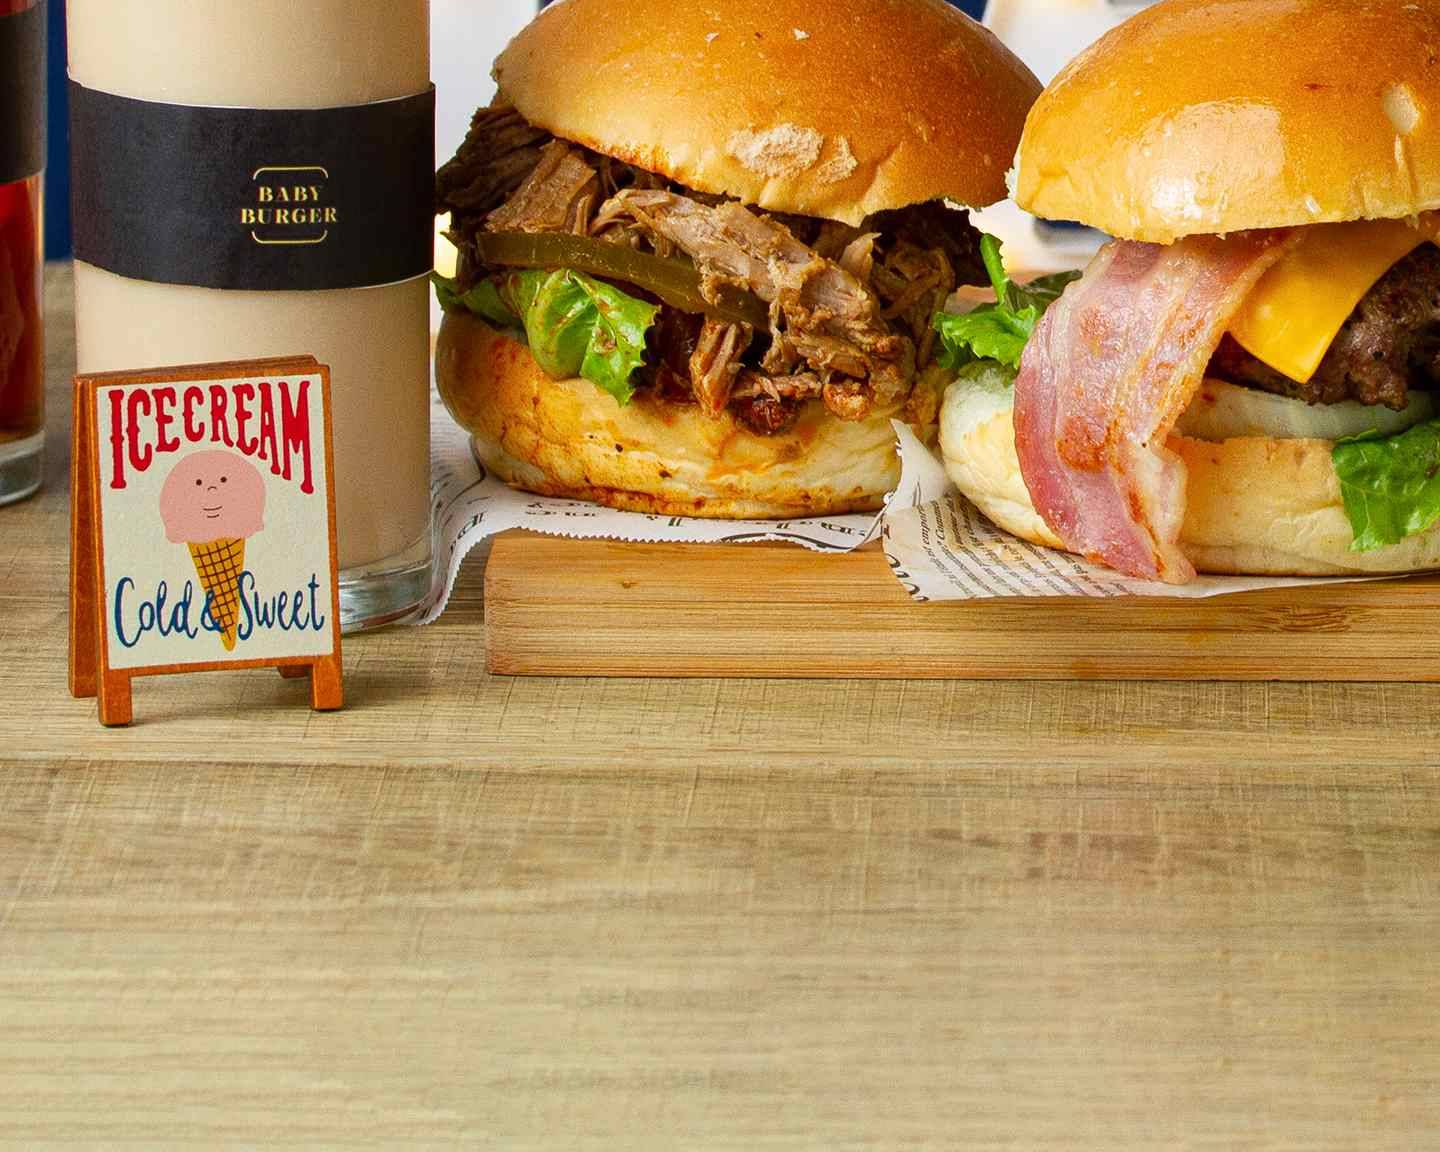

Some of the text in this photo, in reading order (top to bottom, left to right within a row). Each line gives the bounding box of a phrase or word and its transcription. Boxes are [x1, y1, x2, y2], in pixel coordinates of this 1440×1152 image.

[259, 186, 319, 202] BABY
[241, 207, 337, 224] BURGER
[115, 577, 198, 648] Cold
[238, 571, 325, 641] Sweet
